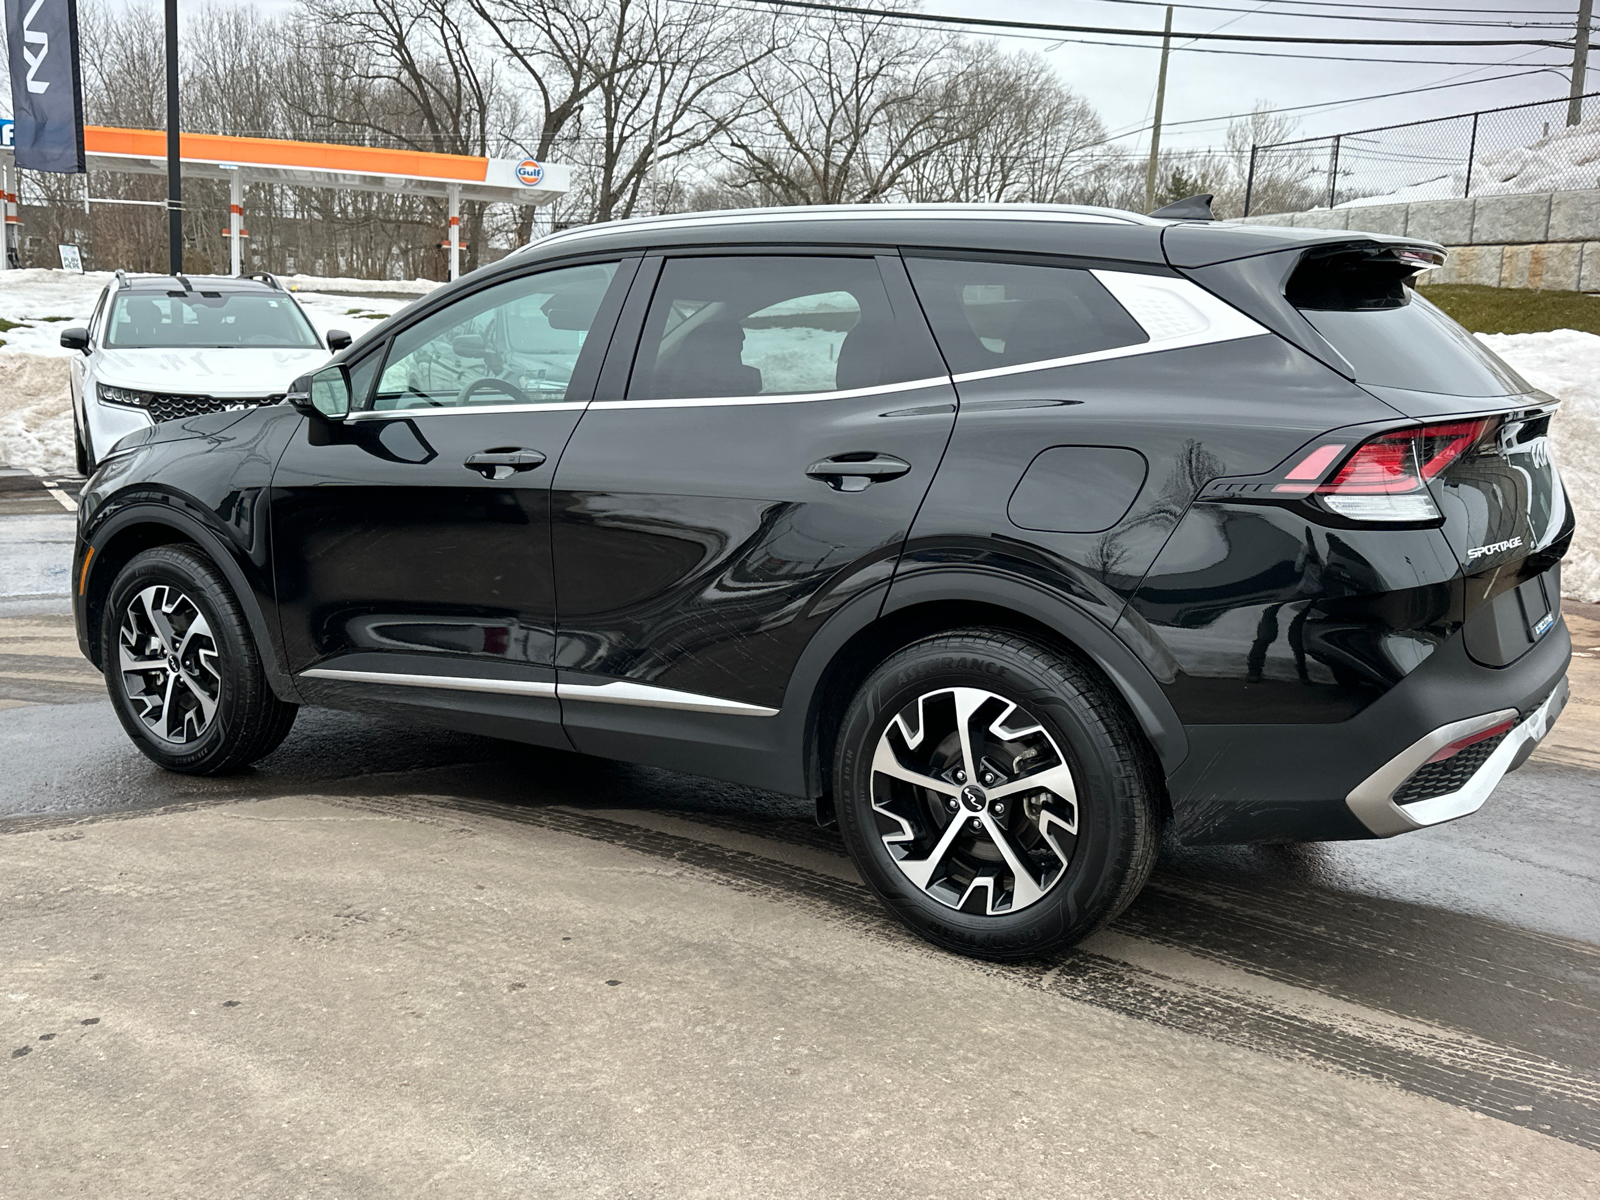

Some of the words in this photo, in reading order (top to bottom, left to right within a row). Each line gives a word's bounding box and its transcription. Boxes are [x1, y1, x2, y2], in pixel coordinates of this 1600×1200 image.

[518, 167, 541, 177] Gulf
[1467, 536, 1523, 559] SPORTAGE
[897, 656, 1010, 687] ASSURANCE
[926, 920, 1042, 950] GOODYEAR
